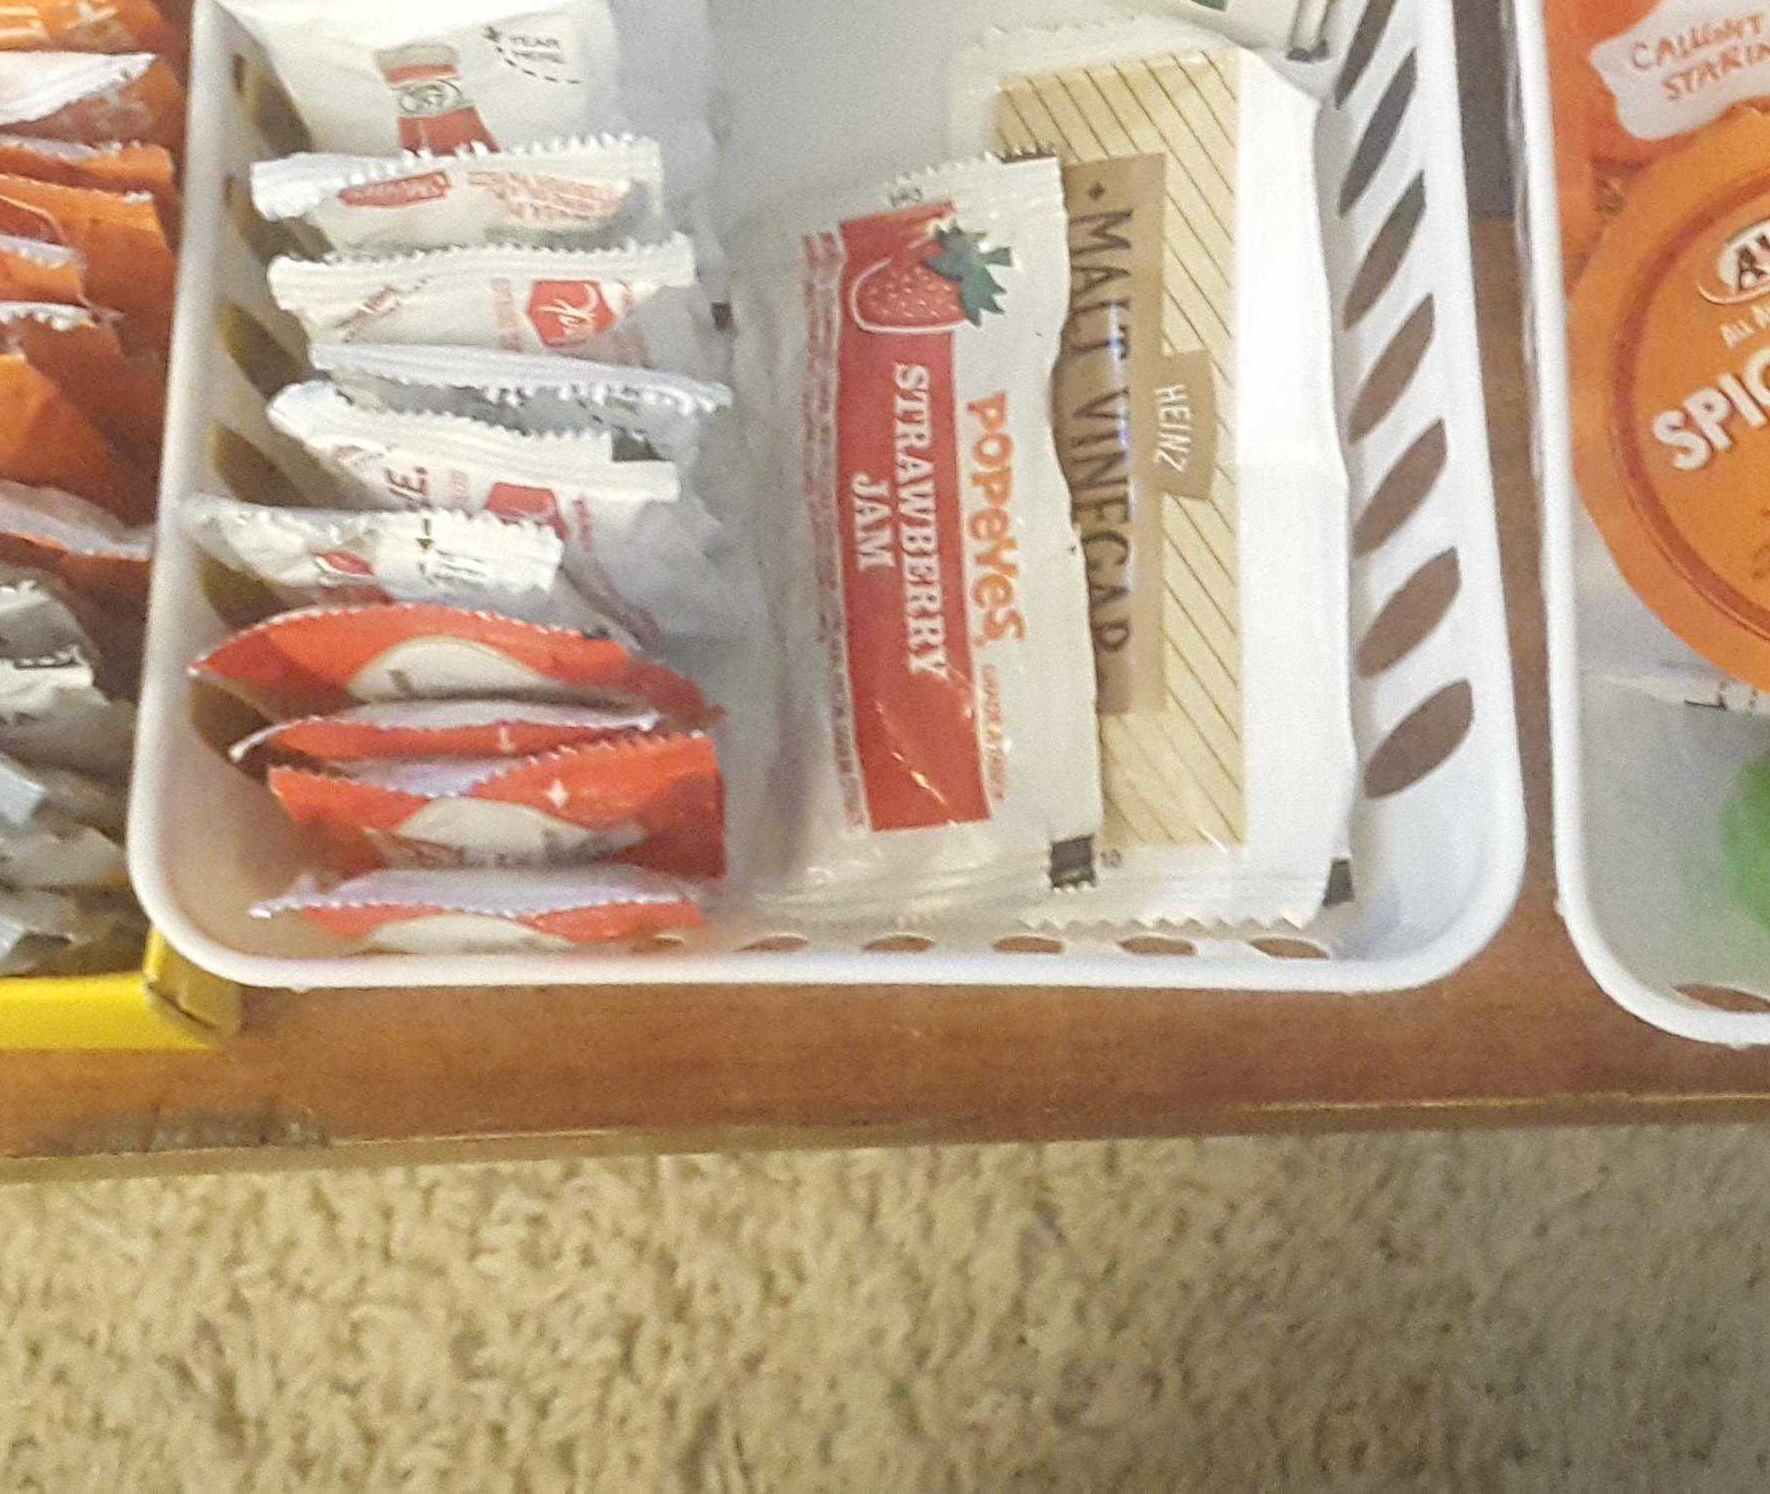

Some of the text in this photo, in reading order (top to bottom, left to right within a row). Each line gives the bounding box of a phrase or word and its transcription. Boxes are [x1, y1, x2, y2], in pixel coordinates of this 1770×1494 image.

[1067, 206, 1134, 362] MALT
[1151, 383, 1192, 473] HEINZ
[851, 470, 897, 572] JAM
[890, 359, 951, 680] STRAWBERRY
